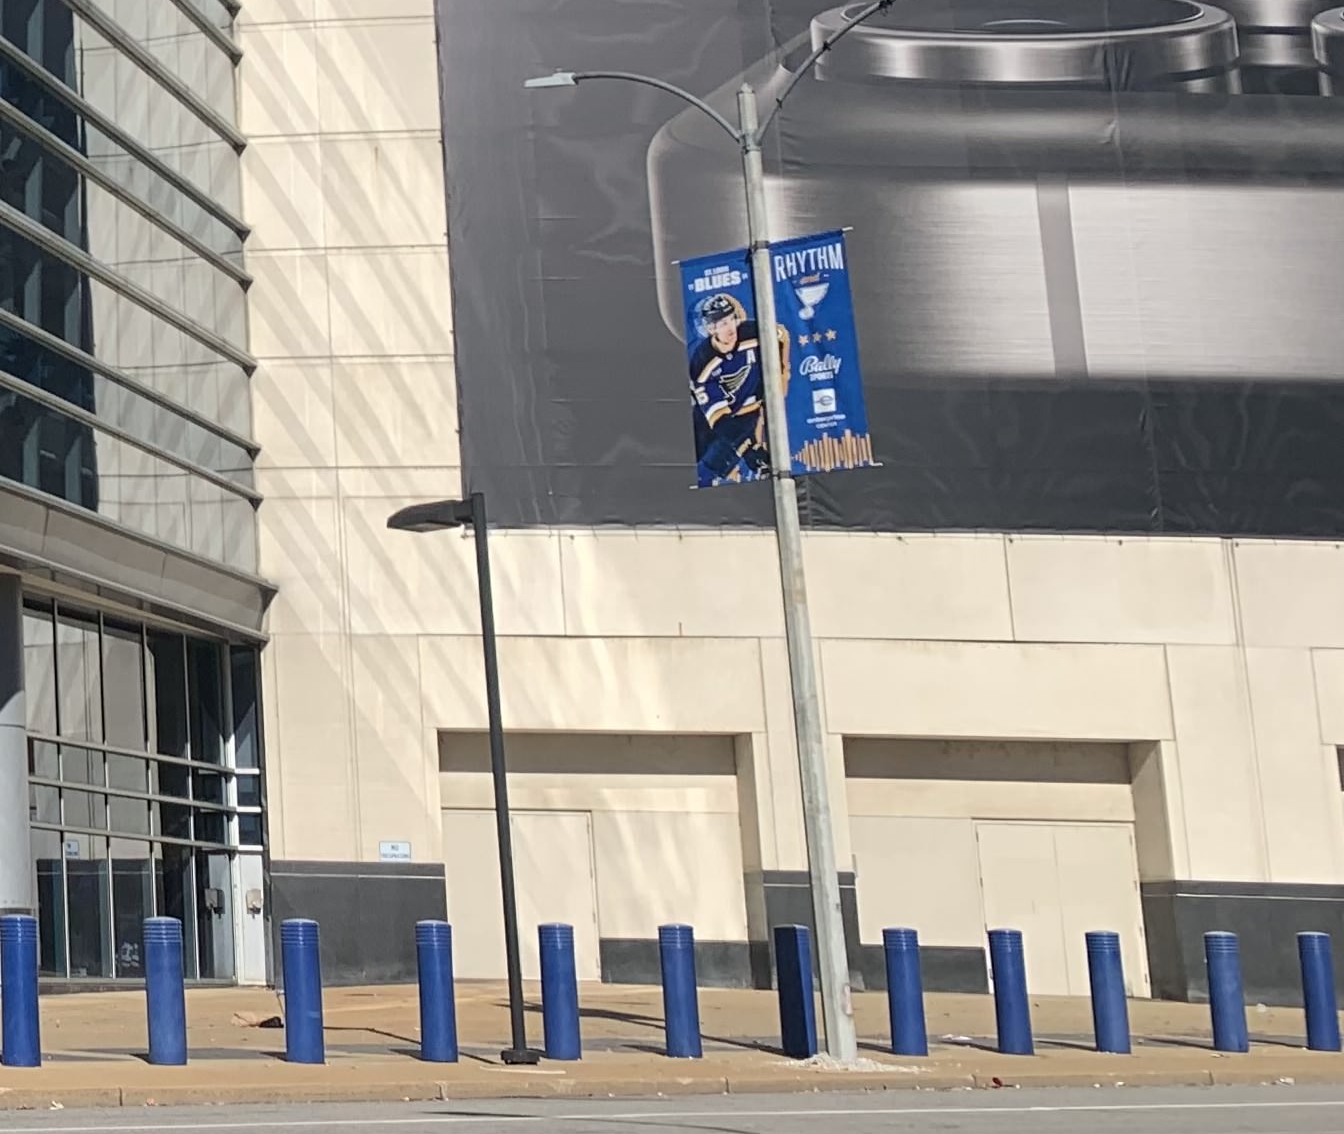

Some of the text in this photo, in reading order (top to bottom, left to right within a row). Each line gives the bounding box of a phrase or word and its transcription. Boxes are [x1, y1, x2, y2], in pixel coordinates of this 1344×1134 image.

[774, 243, 844, 282] RHYTHM
[694, 271, 741, 292] BLUES
[799, 354, 842, 375] Bally
